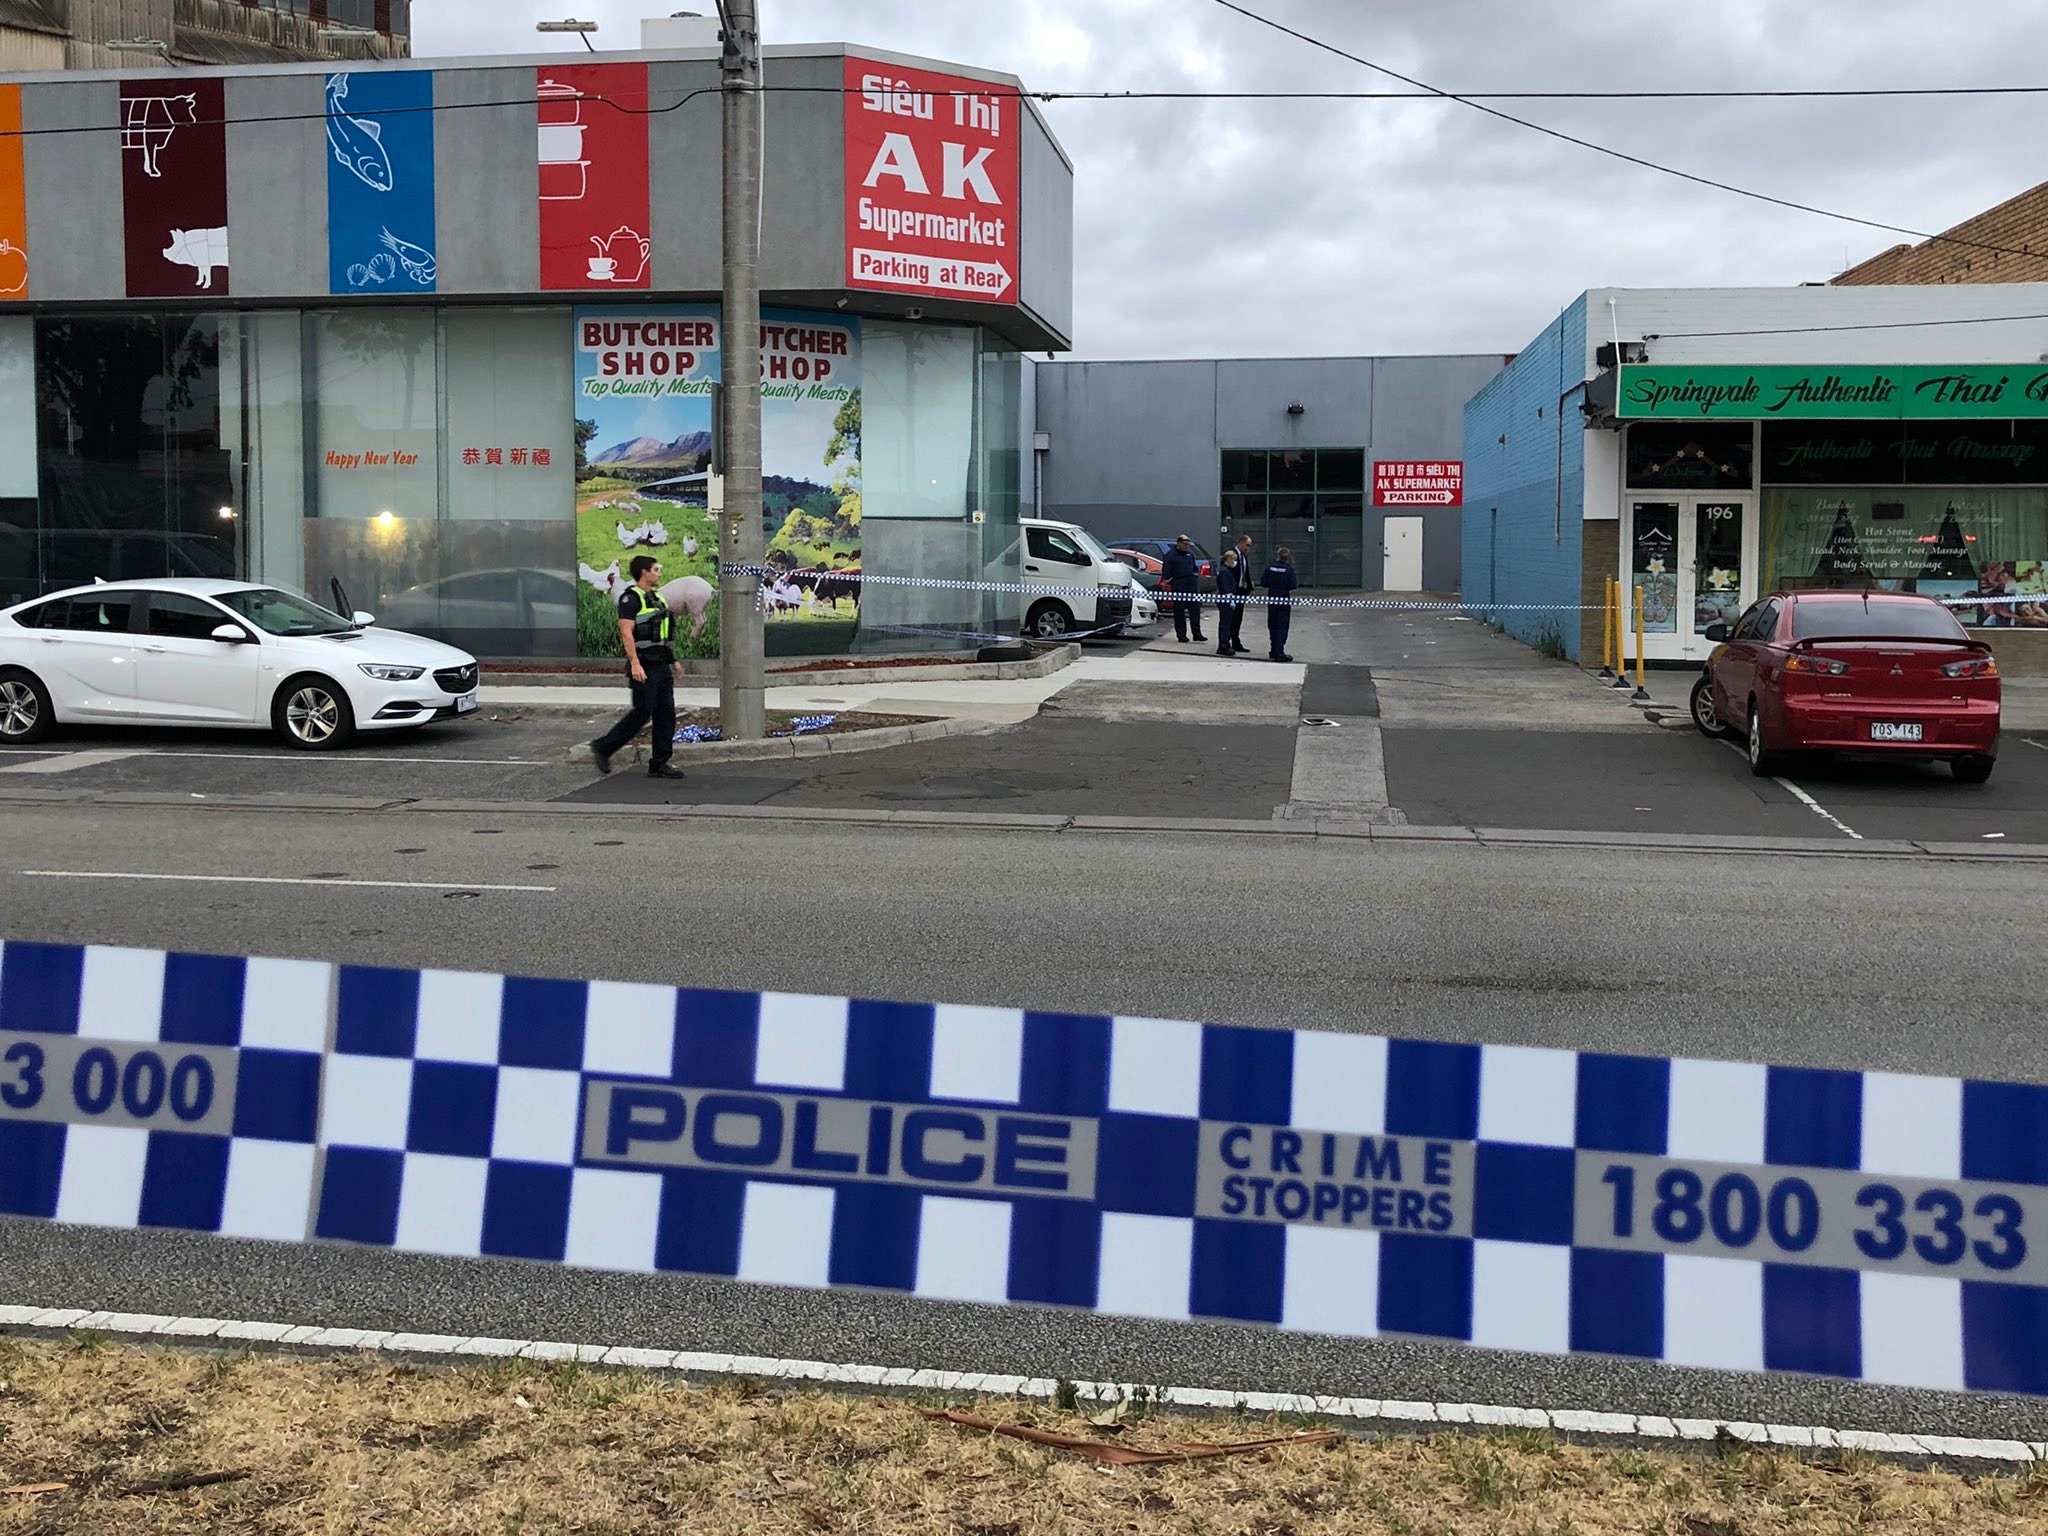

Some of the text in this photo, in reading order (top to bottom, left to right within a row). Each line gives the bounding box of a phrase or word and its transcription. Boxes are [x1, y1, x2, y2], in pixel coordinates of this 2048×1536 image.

[862, 74, 1000, 137] Siêu Thị
[859, 198, 1005, 246] Supermarket
[860, 254, 1003, 287] Parking at Rear
[584, 322, 714, 347] BUTCHER
[760, 326, 847, 355] TCHER
[603, 352, 695, 376] SHOP
[585, 378, 712, 398] Top Quality Meats
[760, 382, 849, 401] Quality Meats
[1626, 378, 1760, 413] Springvale
[1762, 375, 1898, 411] Authentic
[1915, 373, 2009, 404] Thai
[326, 449, 417, 468] Happy New Year
[1377, 478, 1461, 489] AK SUPERMARKET
[1389, 493, 1446, 501] PARKING
[1706, 506, 1733, 519] 196
[1865, 527, 1883, 536] Hot
[1930, 547, 1968, 558] Massage
[1833, 560, 1857, 572] Body
[1859, 560, 1887, 569] Scrub
[1902, 560, 1943, 572] Massage
[1903, 725, 1921, 736] 143
[73, 1047, 214, 1121] 000
[605, 1086, 1072, 1191] POLICE
[1218, 1126, 1454, 1186] CRIME
[1220, 1174, 1454, 1232] STOPPERS
[1602, 1165, 2027, 1271] 1800 333
